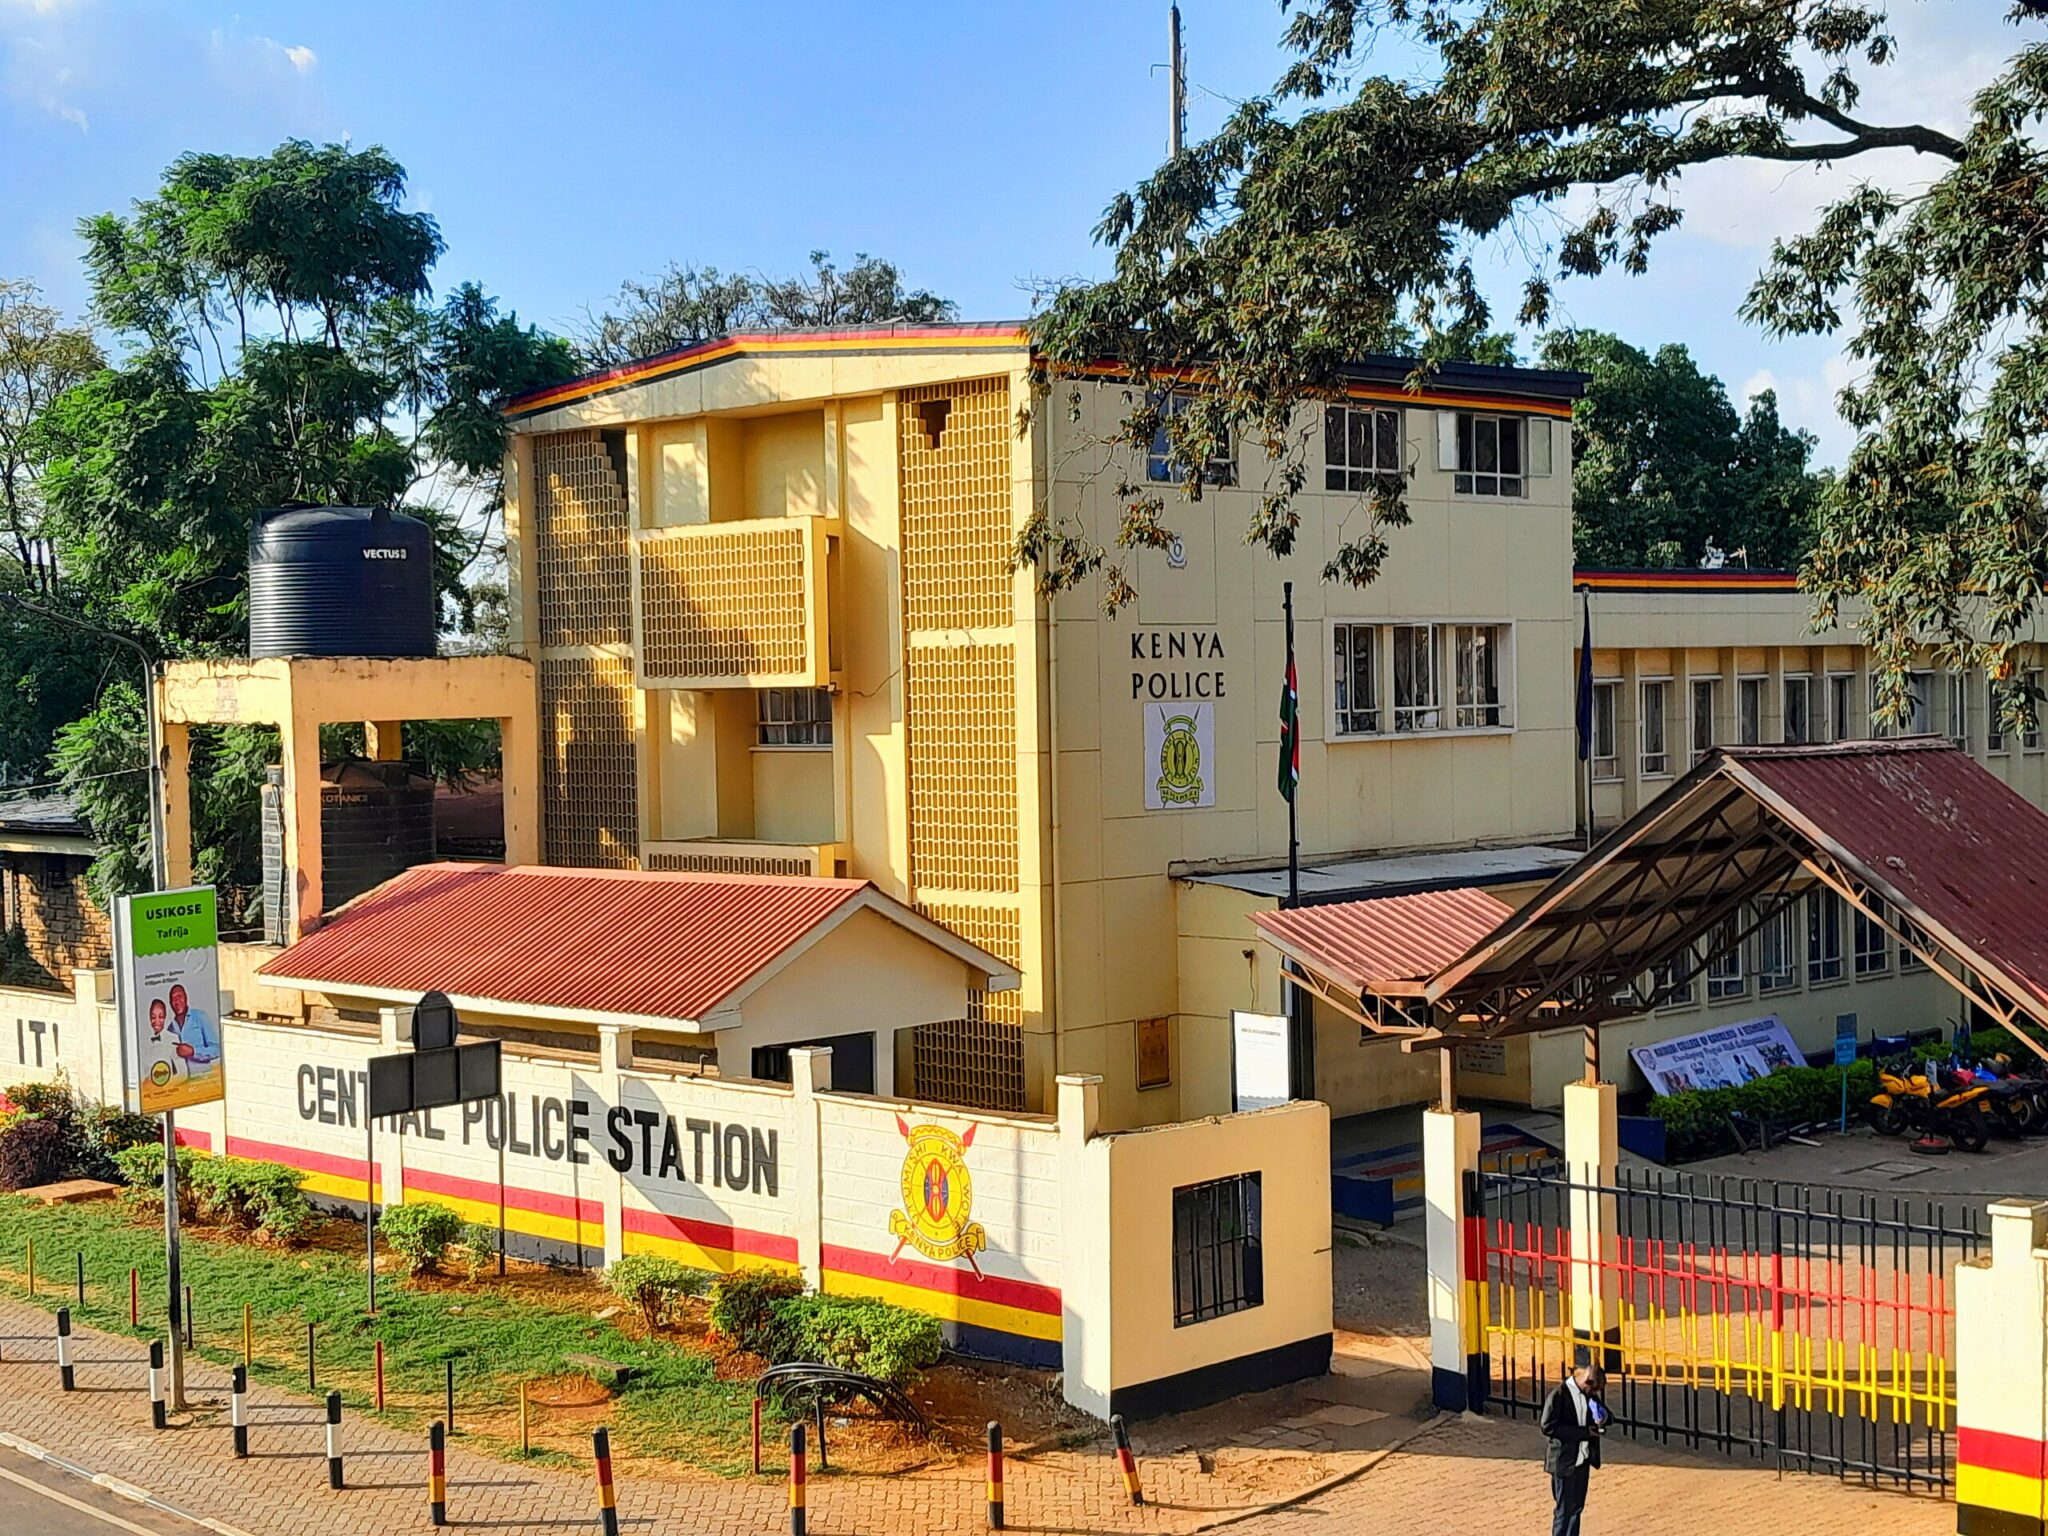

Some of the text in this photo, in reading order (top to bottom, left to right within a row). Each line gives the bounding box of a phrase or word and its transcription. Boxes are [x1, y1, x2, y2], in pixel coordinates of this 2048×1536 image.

[363, 548, 400, 559] VECTUS
[1131, 632, 1225, 659] KENYA
[1132, 672, 1226, 699] POLICE
[145, 903, 202, 920] USIKOSE
[156, 926, 189, 939] Tafrija
[16, 1018, 60, 1075] IT!
[462, 1091, 590, 1165] POLICE
[607, 1105, 779, 1198] STATION
[902, 1143, 971, 1233] UTUMISHI KWA WOTE
[904, 1225, 971, 1258] KENYA POLICE
